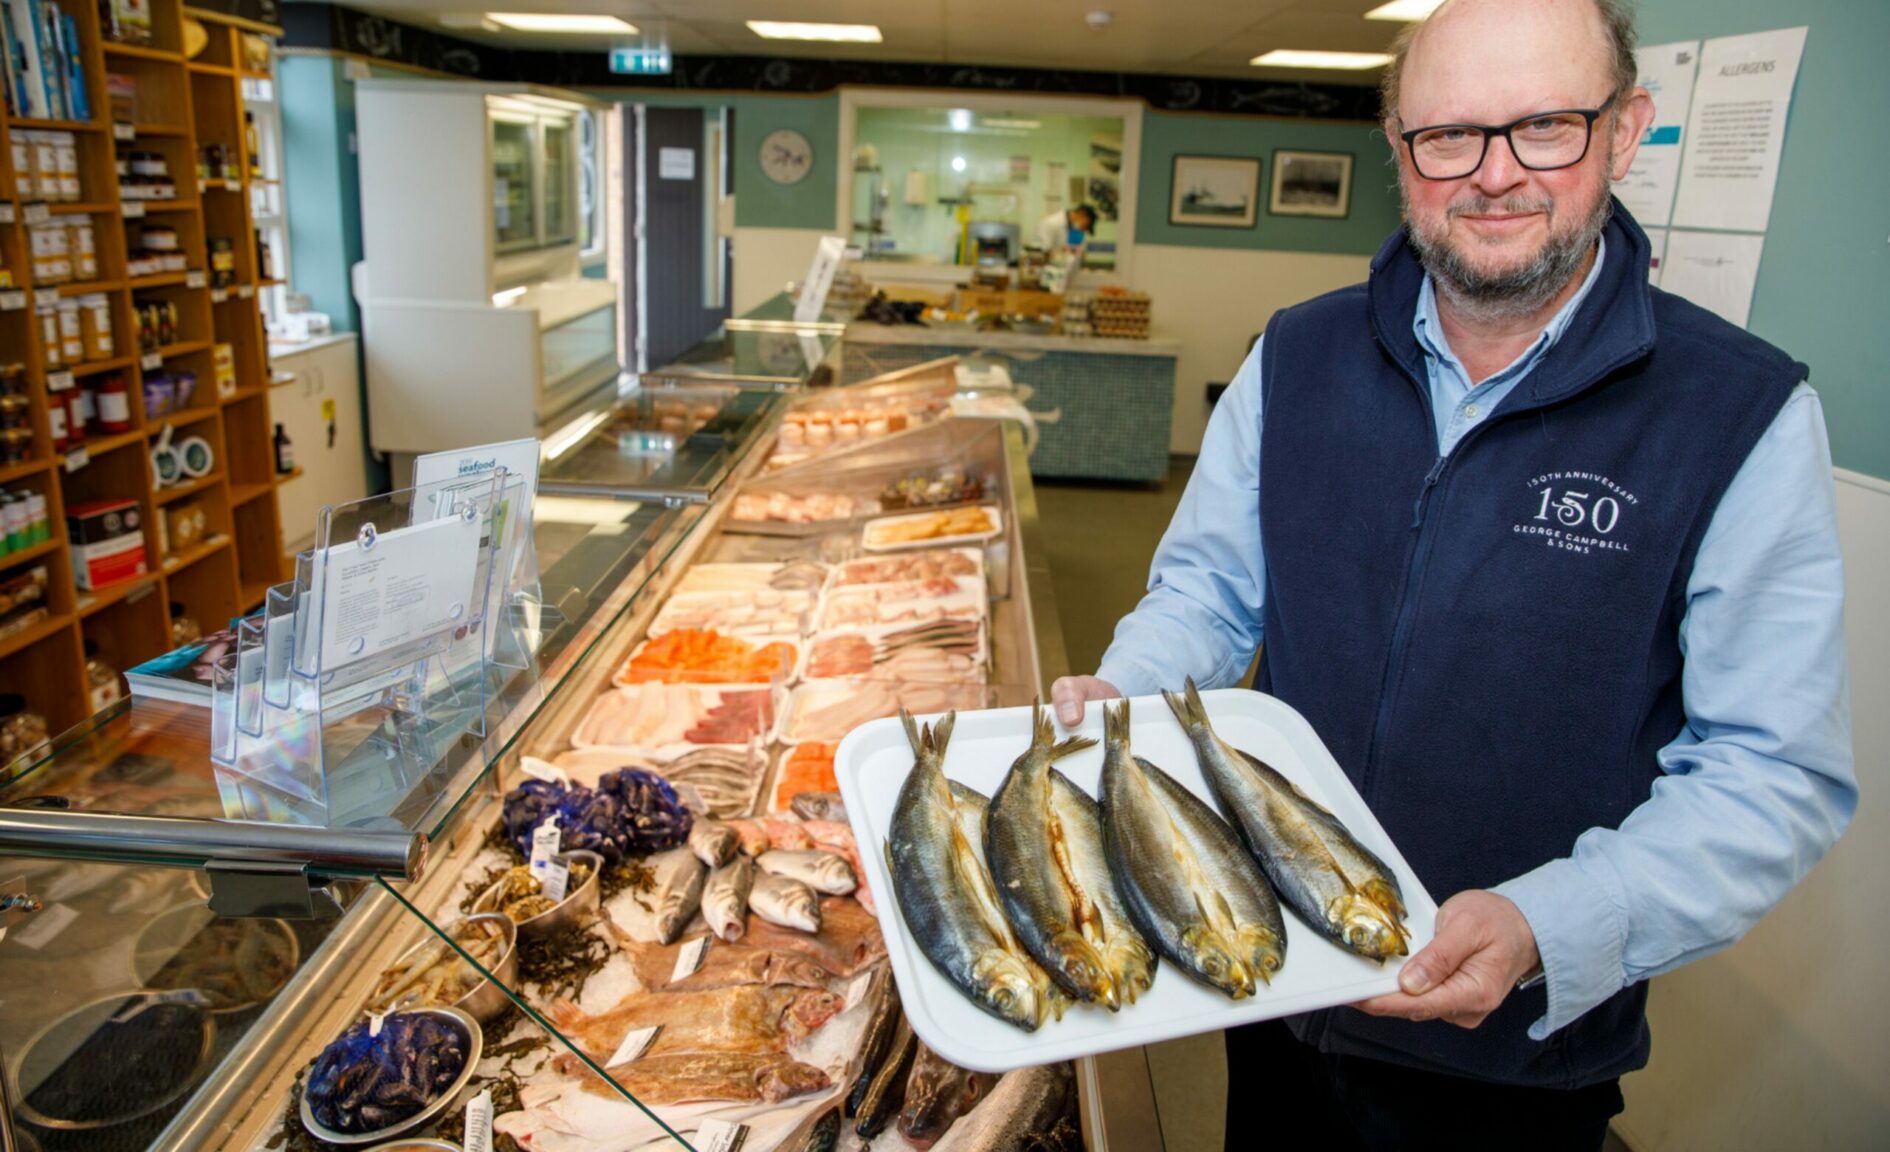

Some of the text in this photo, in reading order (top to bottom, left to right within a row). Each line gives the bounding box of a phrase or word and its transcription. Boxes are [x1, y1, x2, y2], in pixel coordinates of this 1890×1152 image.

[1718, 60, 1776, 77] ALLERGENS
[458, 458, 496, 473] seafood
[1527, 471, 1638, 505] 150TH ANNIVERSARY
[1533, 487, 1619, 534] 150
[1513, 524, 1629, 551] GEORGE CAMPBELL
[1547, 538, 1590, 554] & SONS
